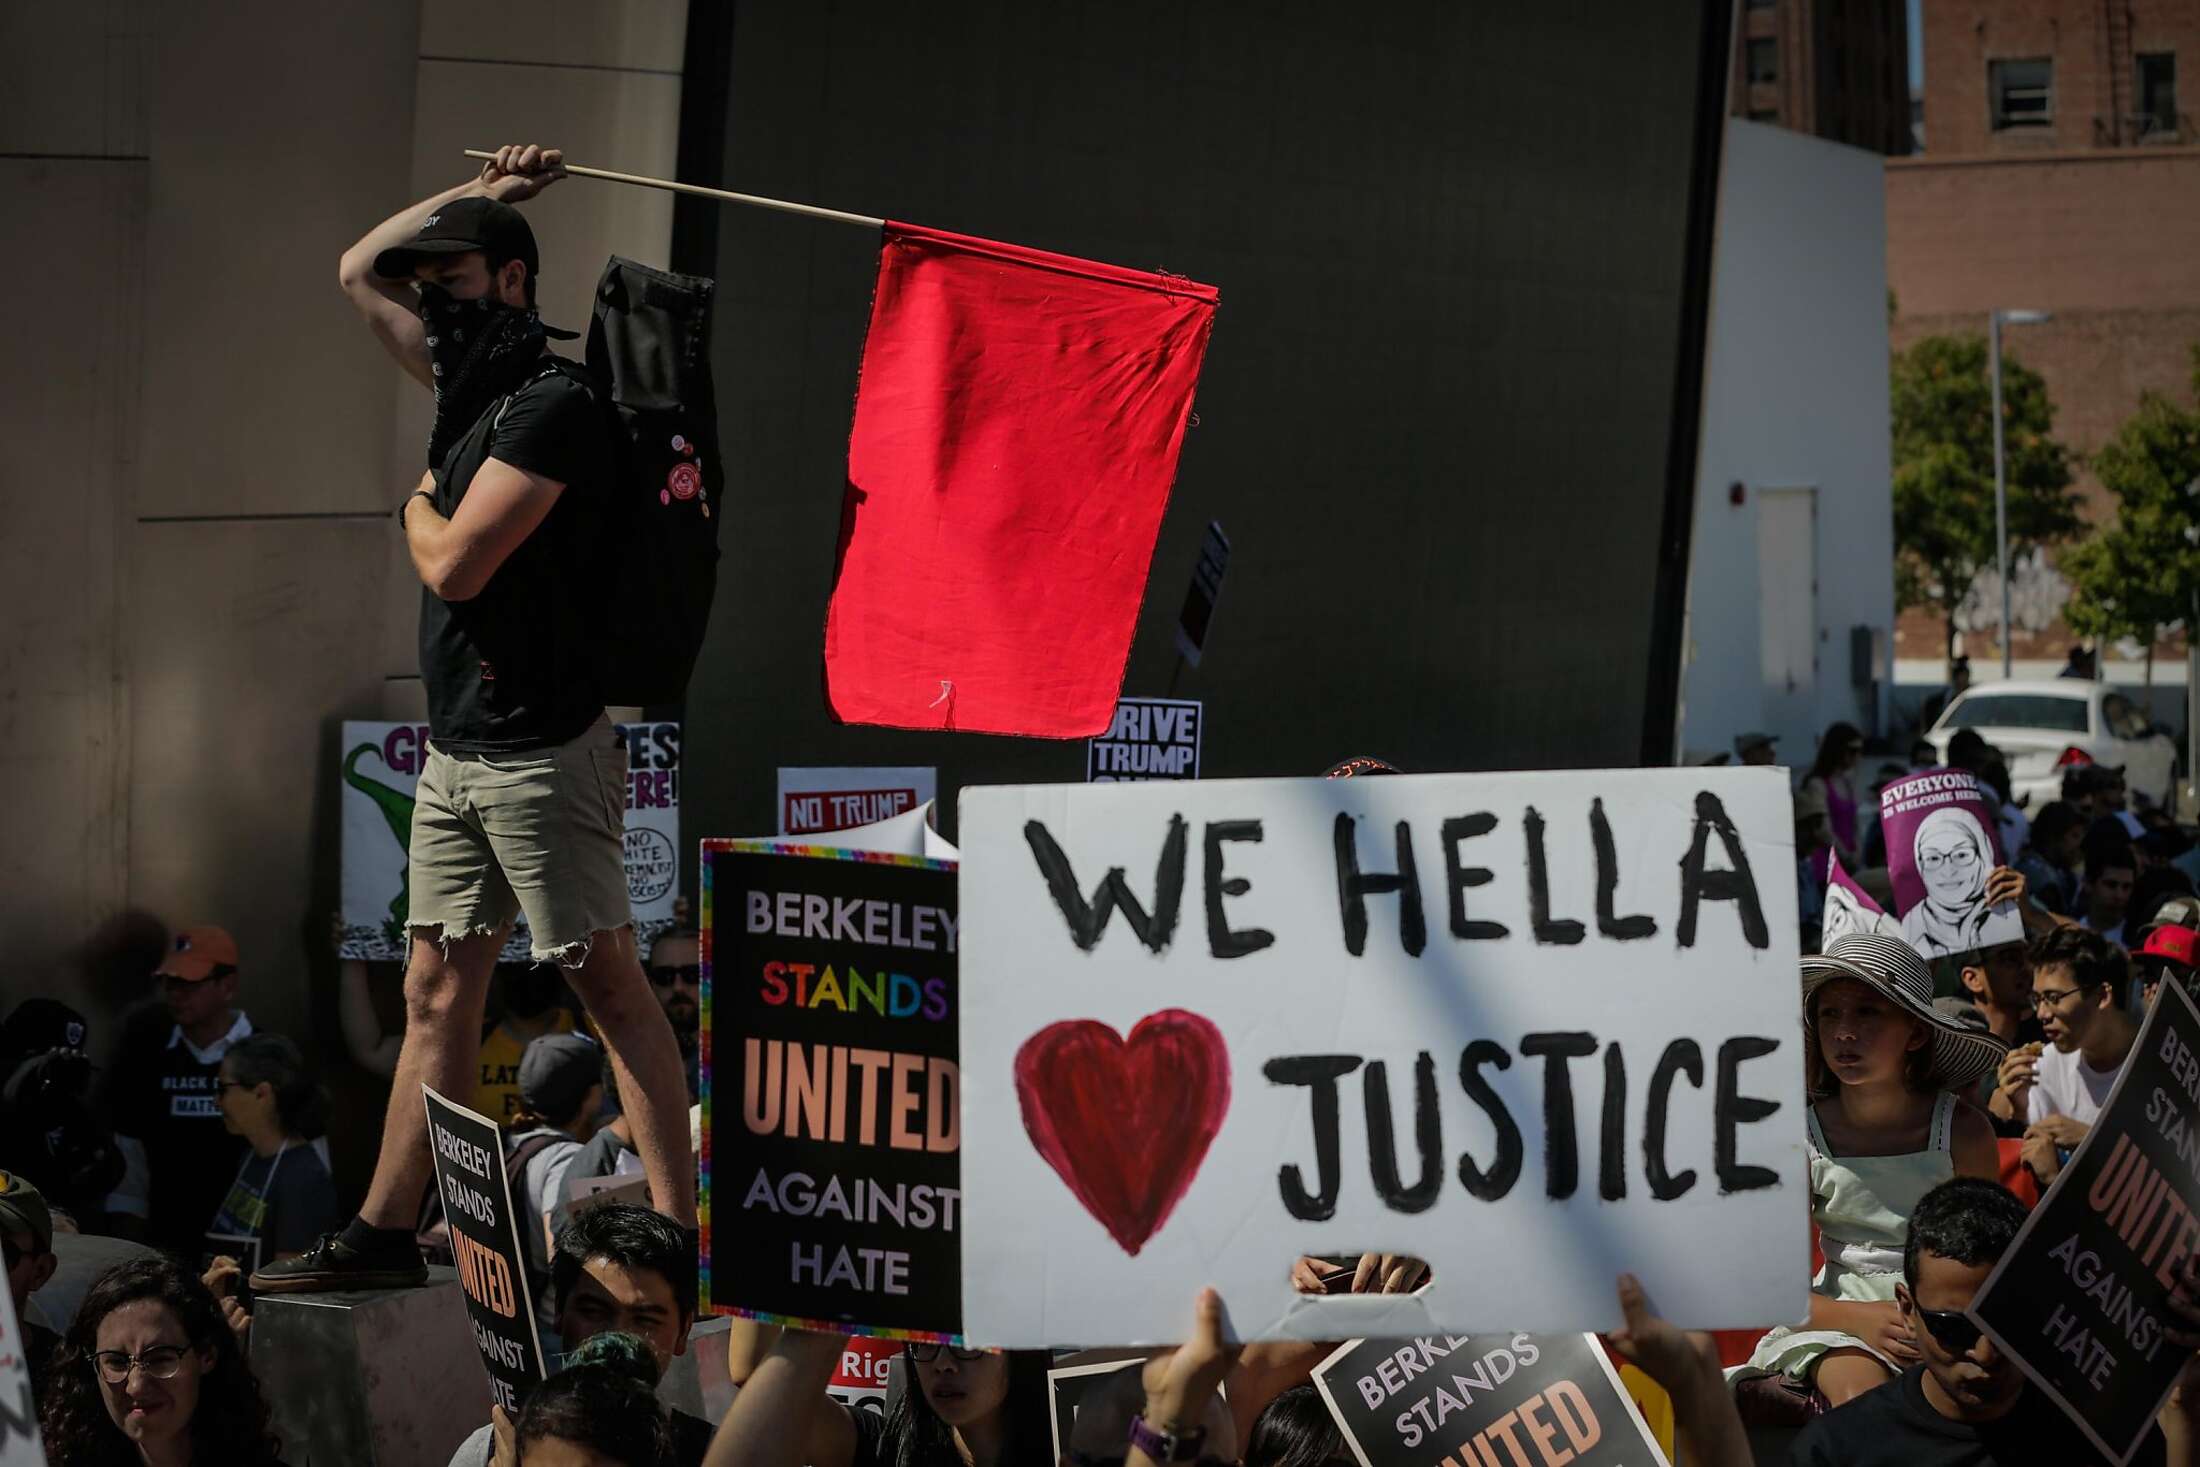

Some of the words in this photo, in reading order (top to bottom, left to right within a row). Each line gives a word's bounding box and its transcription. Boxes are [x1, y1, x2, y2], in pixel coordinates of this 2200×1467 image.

[1103, 705, 1196, 743] RIVE
[1094, 742, 1194, 774] TRUMP
[791, 797, 823, 828] NO
[829, 792, 908, 825] TRUMP
[1896, 790, 1953, 813] WELCOME
[624, 846, 662, 861] HITE
[626, 832, 651, 848] NO
[1023, 813, 1275, 959] WE
[1333, 791, 1769, 957] HELLA
[746, 890, 958, 953] BERKELEY
[760, 960, 947, 1022] STANDS
[162, 1076, 208, 1089] BLACK
[482, 1064, 519, 1085] LAT
[743, 1037, 959, 1153] UNITED
[435, 1122, 492, 1180] BERKELEY
[1263, 1032, 1783, 1221] JUSTICE
[445, 1173, 496, 1227] STANDS
[743, 1167, 960, 1231] AGAINST
[2089, 1131, 2200, 1294] UNITE
[790, 1241, 910, 1295] HATE
[841, 1351, 890, 1386] Rig
[2041, 1303, 2118, 1391] HATE
[1396, 1333, 1541, 1448] STANDS
